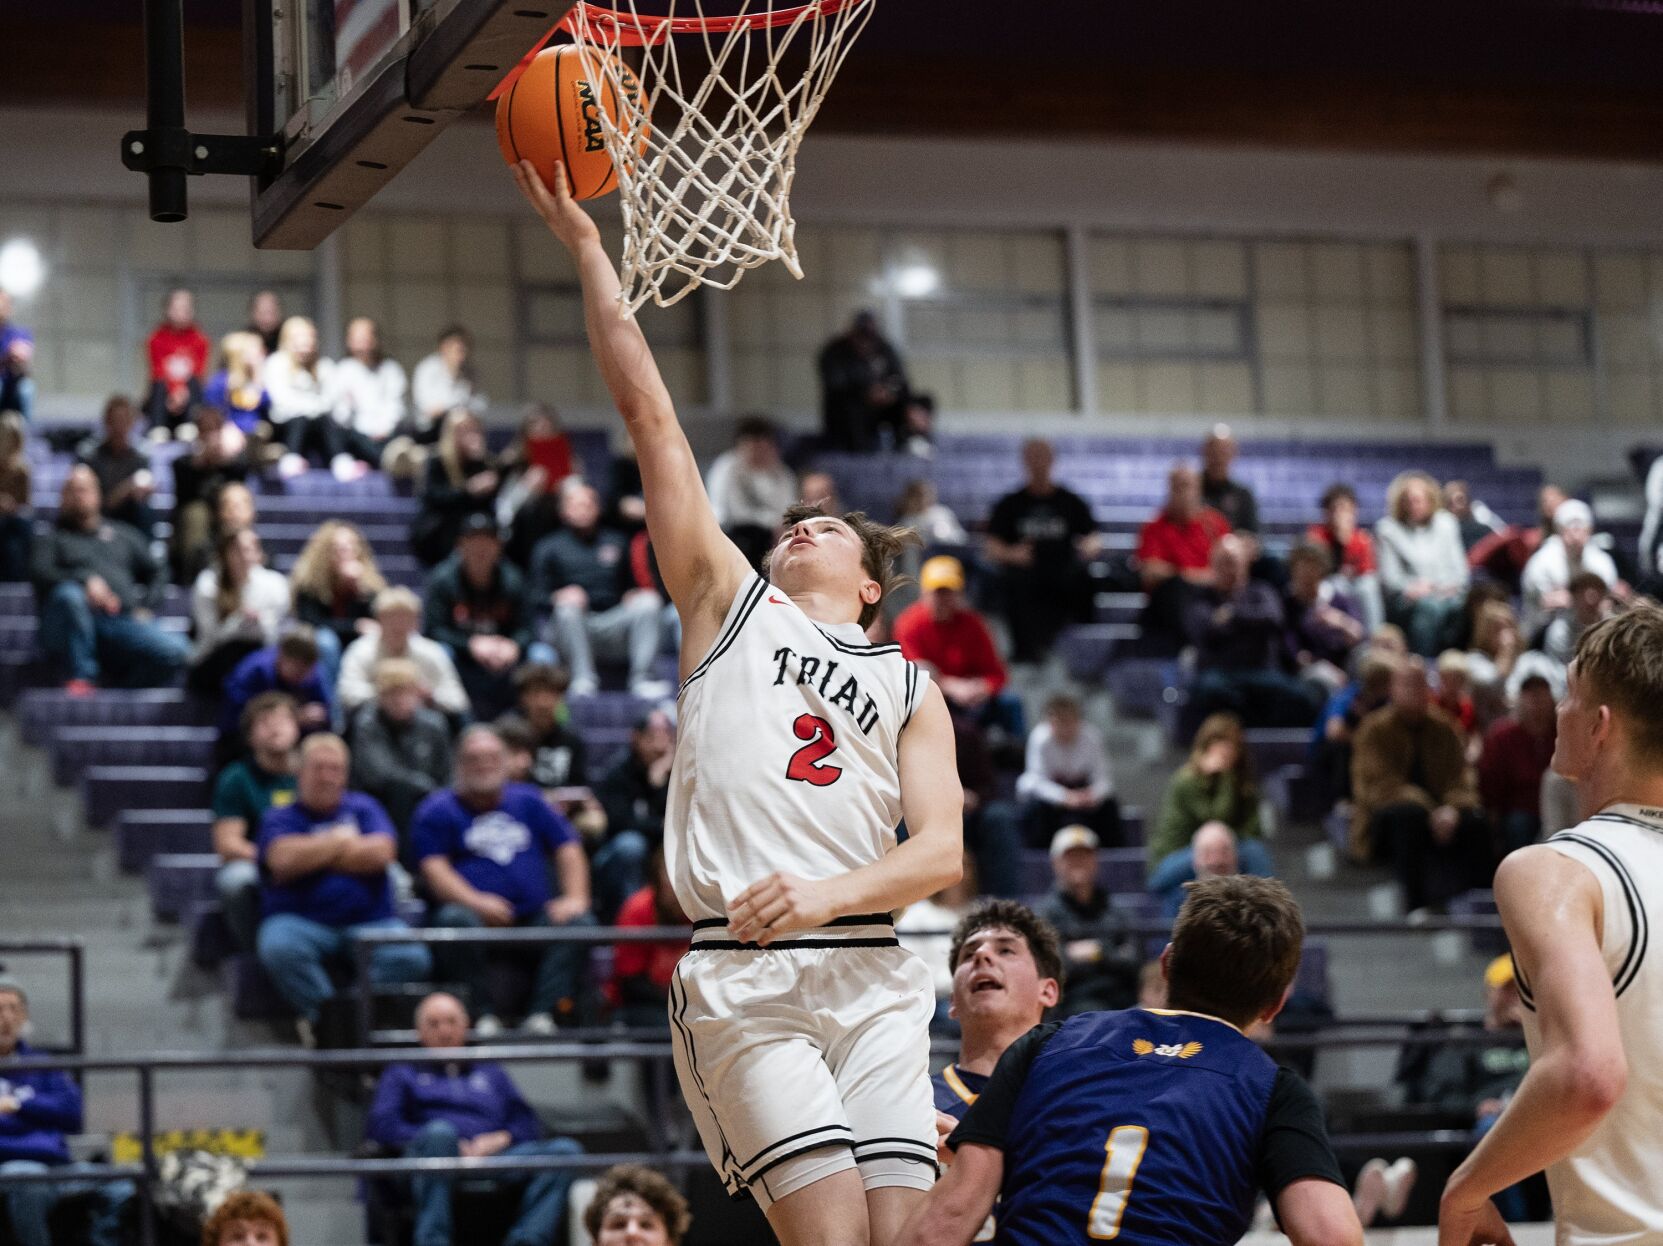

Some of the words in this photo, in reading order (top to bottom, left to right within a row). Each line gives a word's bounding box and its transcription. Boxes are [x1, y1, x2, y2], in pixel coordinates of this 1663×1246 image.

[576, 80, 605, 152] NCAA
[773, 646, 880, 736] TRIAD
[785, 712, 843, 787] 2
[1087, 1125, 1149, 1240] 1
